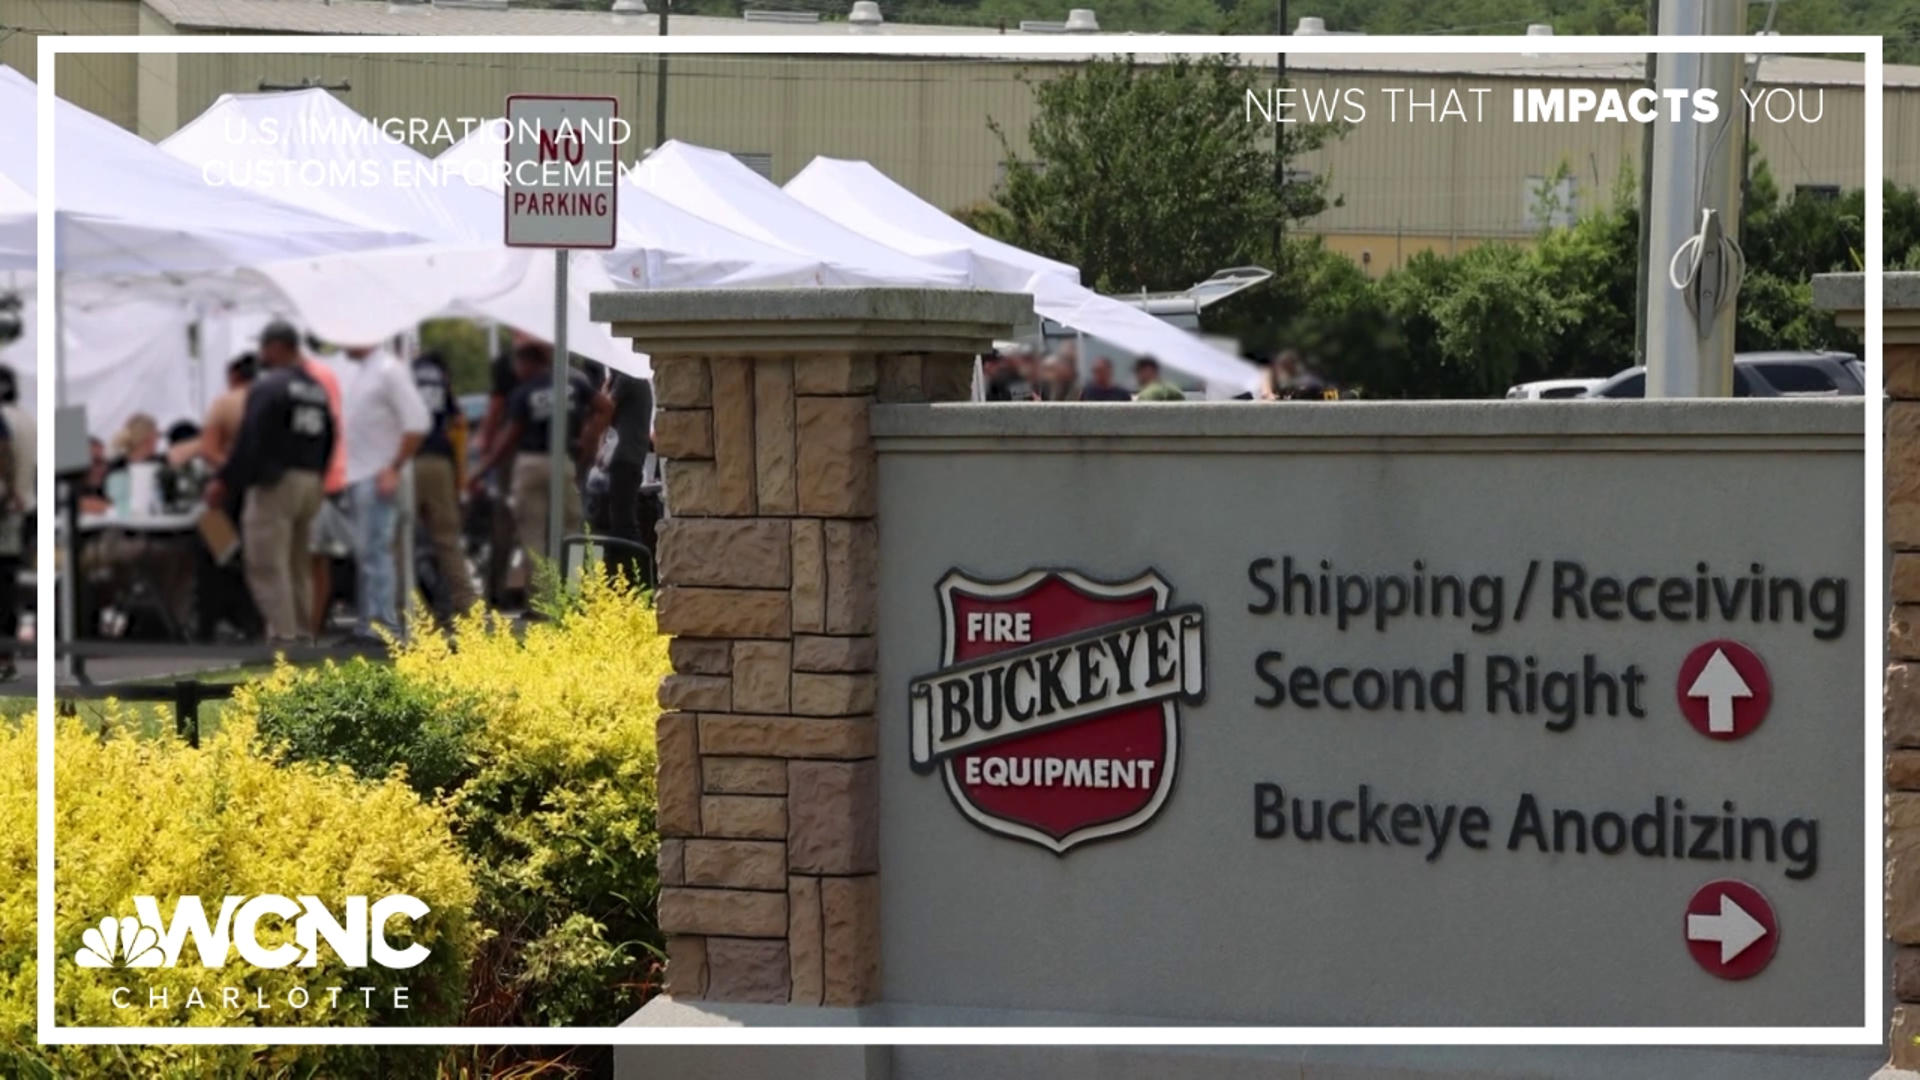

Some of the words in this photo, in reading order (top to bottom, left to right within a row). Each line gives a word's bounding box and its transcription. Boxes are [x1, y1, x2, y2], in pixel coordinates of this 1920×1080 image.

[538, 128, 584, 166] NO
[513, 192, 608, 217] PARKING
[967, 612, 1032, 643] FIRE
[939, 621, 1177, 743] BUCKEYE
[1254, 651, 1465, 712] Second
[1486, 654, 1646, 733] Right
[965, 756, 1155, 789] EQUIPMENT
[1254, 782, 1490, 862] Buckeye
[1507, 793, 1819, 880] Anodizing
